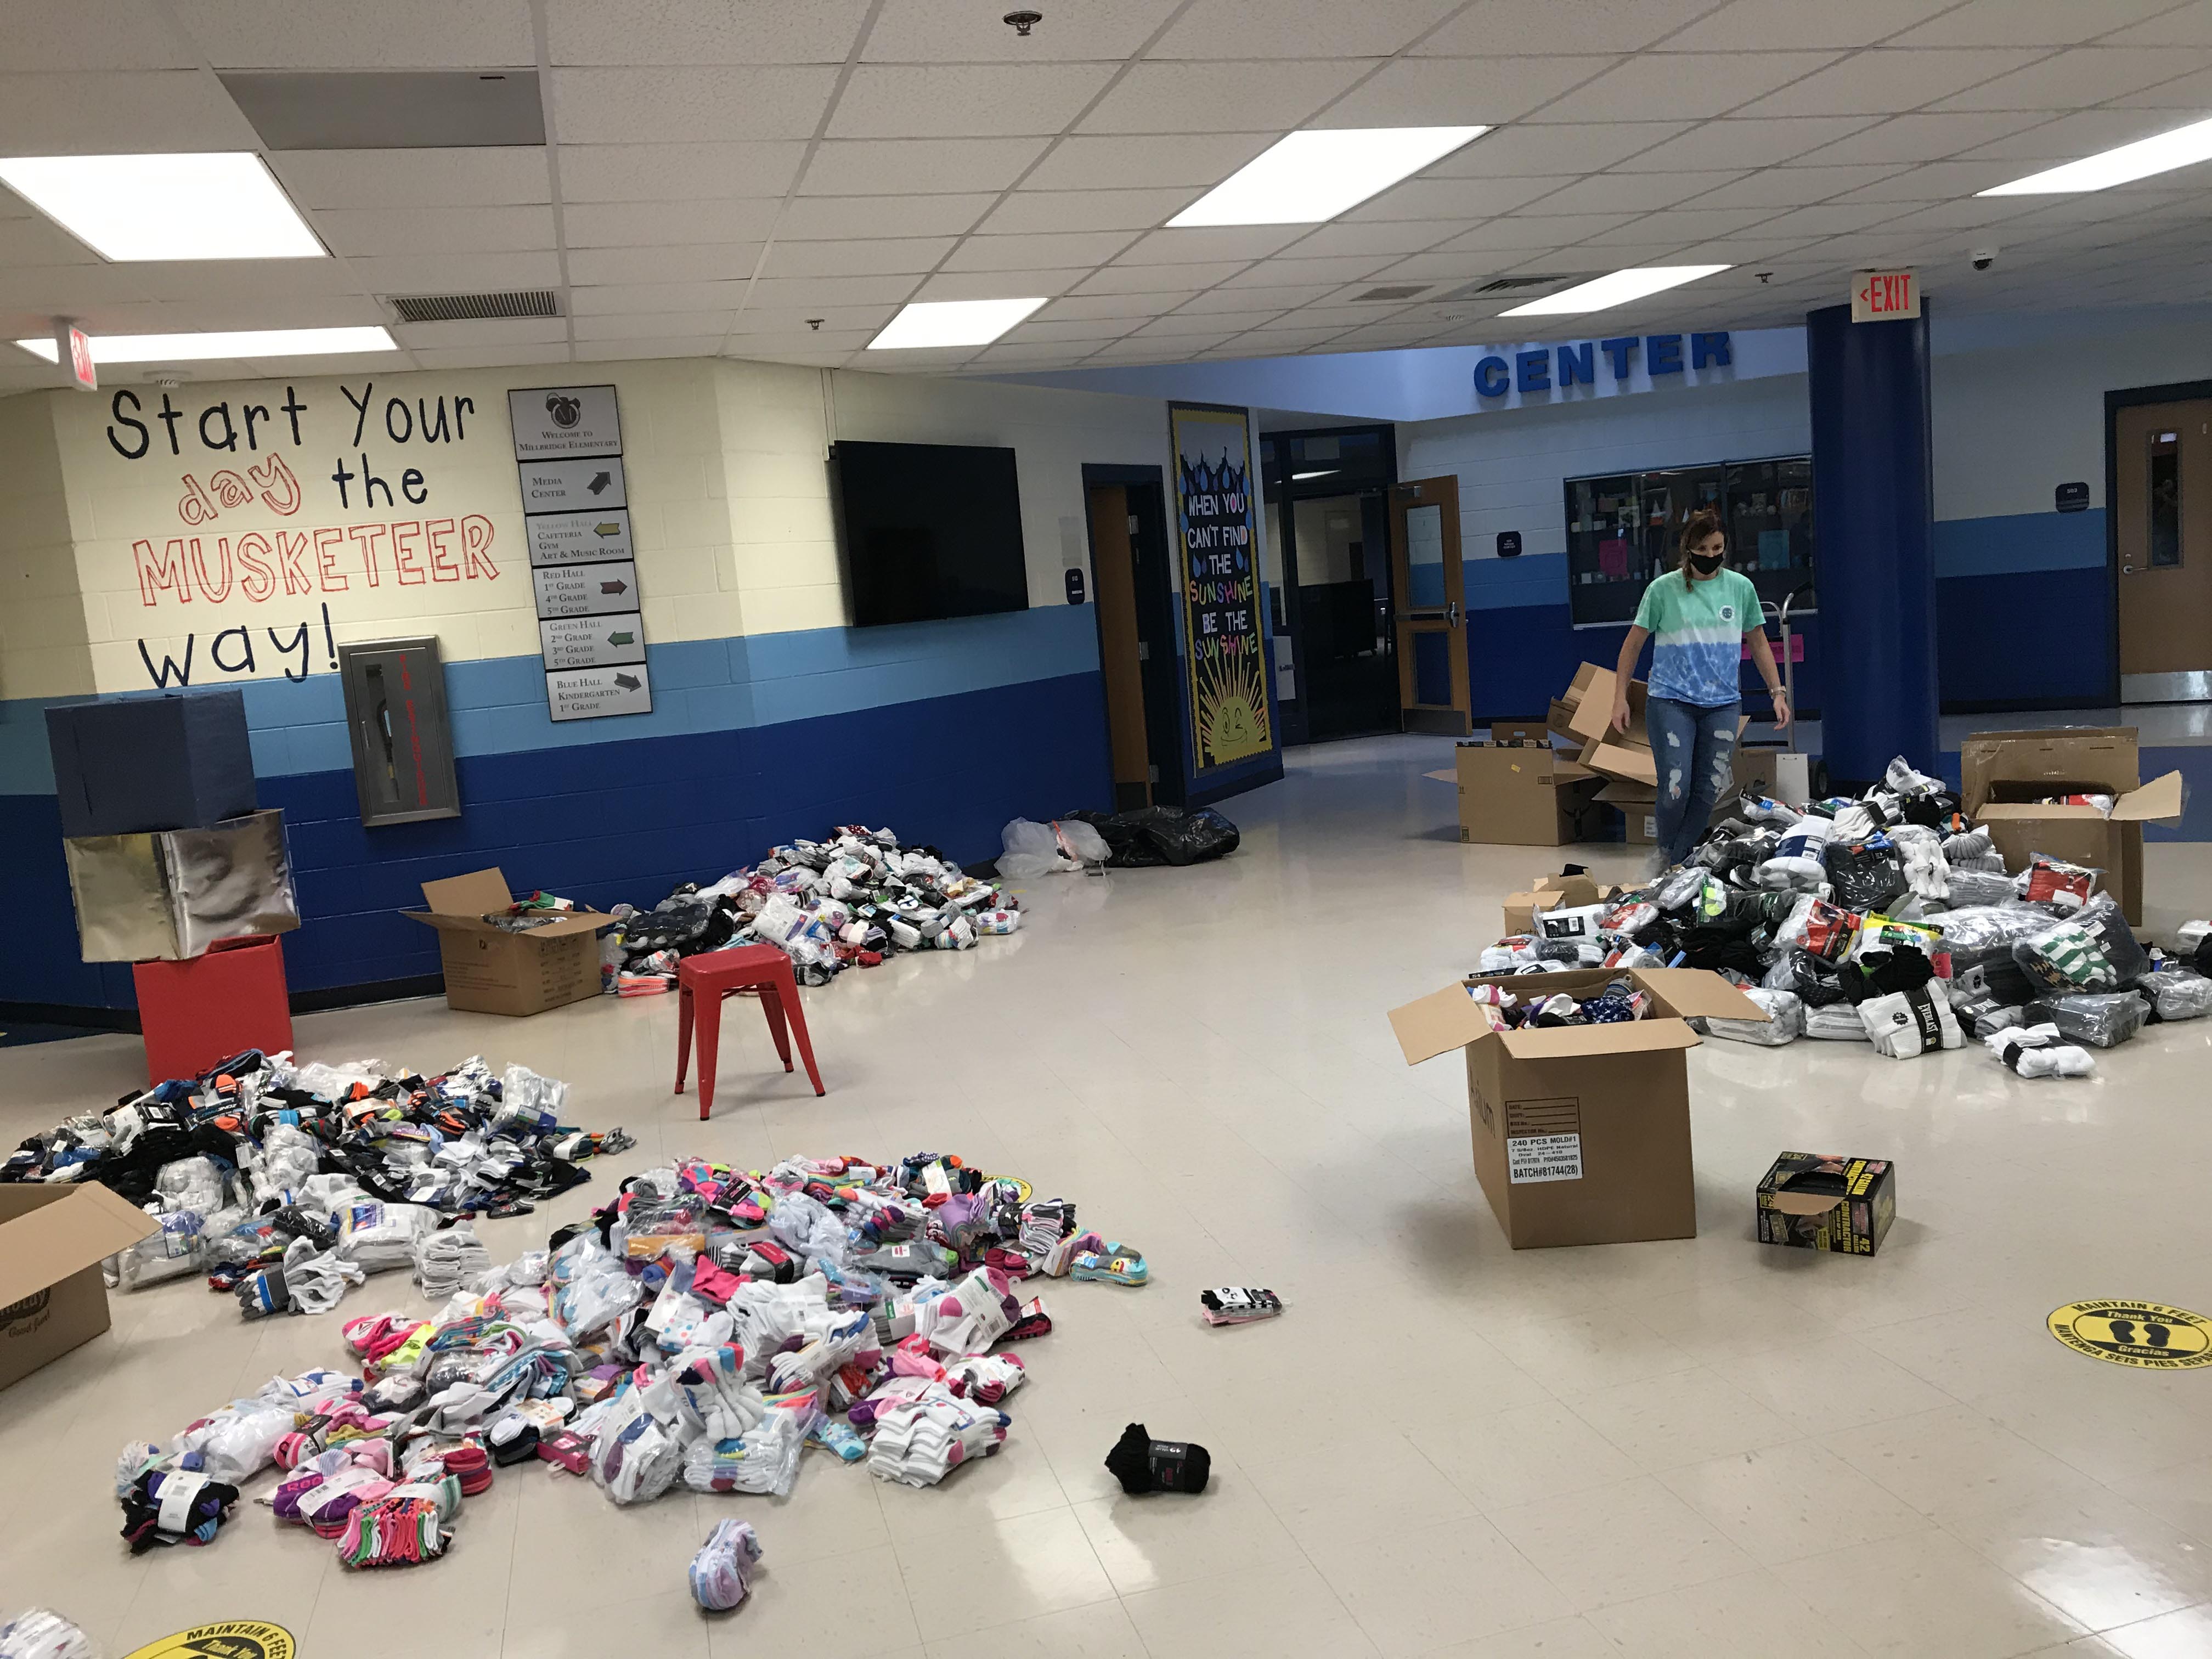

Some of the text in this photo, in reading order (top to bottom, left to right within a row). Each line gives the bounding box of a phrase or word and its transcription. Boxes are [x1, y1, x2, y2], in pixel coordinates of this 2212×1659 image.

[1870, 274, 1911, 312] EXIT
[1474, 331, 1731, 397] CENTER
[107, 382, 475, 460] Start Your
[519, 443, 566, 452] MILLBRIDGE
[532, 477, 562, 486] MEDIA
[178, 452, 428, 526] day the
[531, 489, 566, 498] CENTER
[1189, 493, 1244, 516] WHEN YOU
[1188, 524, 1248, 549] CAN'T FIND
[132, 514, 500, 607] MUSKETEER
[1209, 554, 1232, 575] THE
[543, 569, 585, 579] RED HALL
[556, 582, 585, 590] GRADE
[1189, 575, 1253, 605] SUNSHINE
[559, 594, 588, 602] GRADE
[561, 605, 590, 614] GRADE
[549, 620, 602, 631] GREEN HALL
[1202, 610, 1248, 634] BE THE
[565, 634, 593, 642] GRADE
[139, 602, 338, 690] way!
[566, 645, 595, 653] GRADE
[1195, 632, 1258, 660] SUNSHINE
[567, 657, 596, 665] GRADE
[557, 678, 602, 689] BLUE HALL
[558, 690, 620, 701] KINDERGARTEN
[572, 703, 601, 711] GRADE
[1917, 1003, 1939, 1034] EVERLAST
[1514, 1164, 1578, 1179] BATCH#81744(28)
[1841, 1200, 1852, 1252] CONTRACTOR
[1859, 1238, 1870, 1252] 42
[2070, 1301, 2147, 1312] MAINTAIN
[2168, 1308, 2208, 1325] FEET
[2107, 1311, 2173, 1324] Thank You
[2117, 1345, 2170, 1357] Gracias
[2105, 1353, 2139, 1365] SEIS
[2143, 1359, 2179, 1367] PIES
[187, 1624, 271, 1640] MAINTAIN
